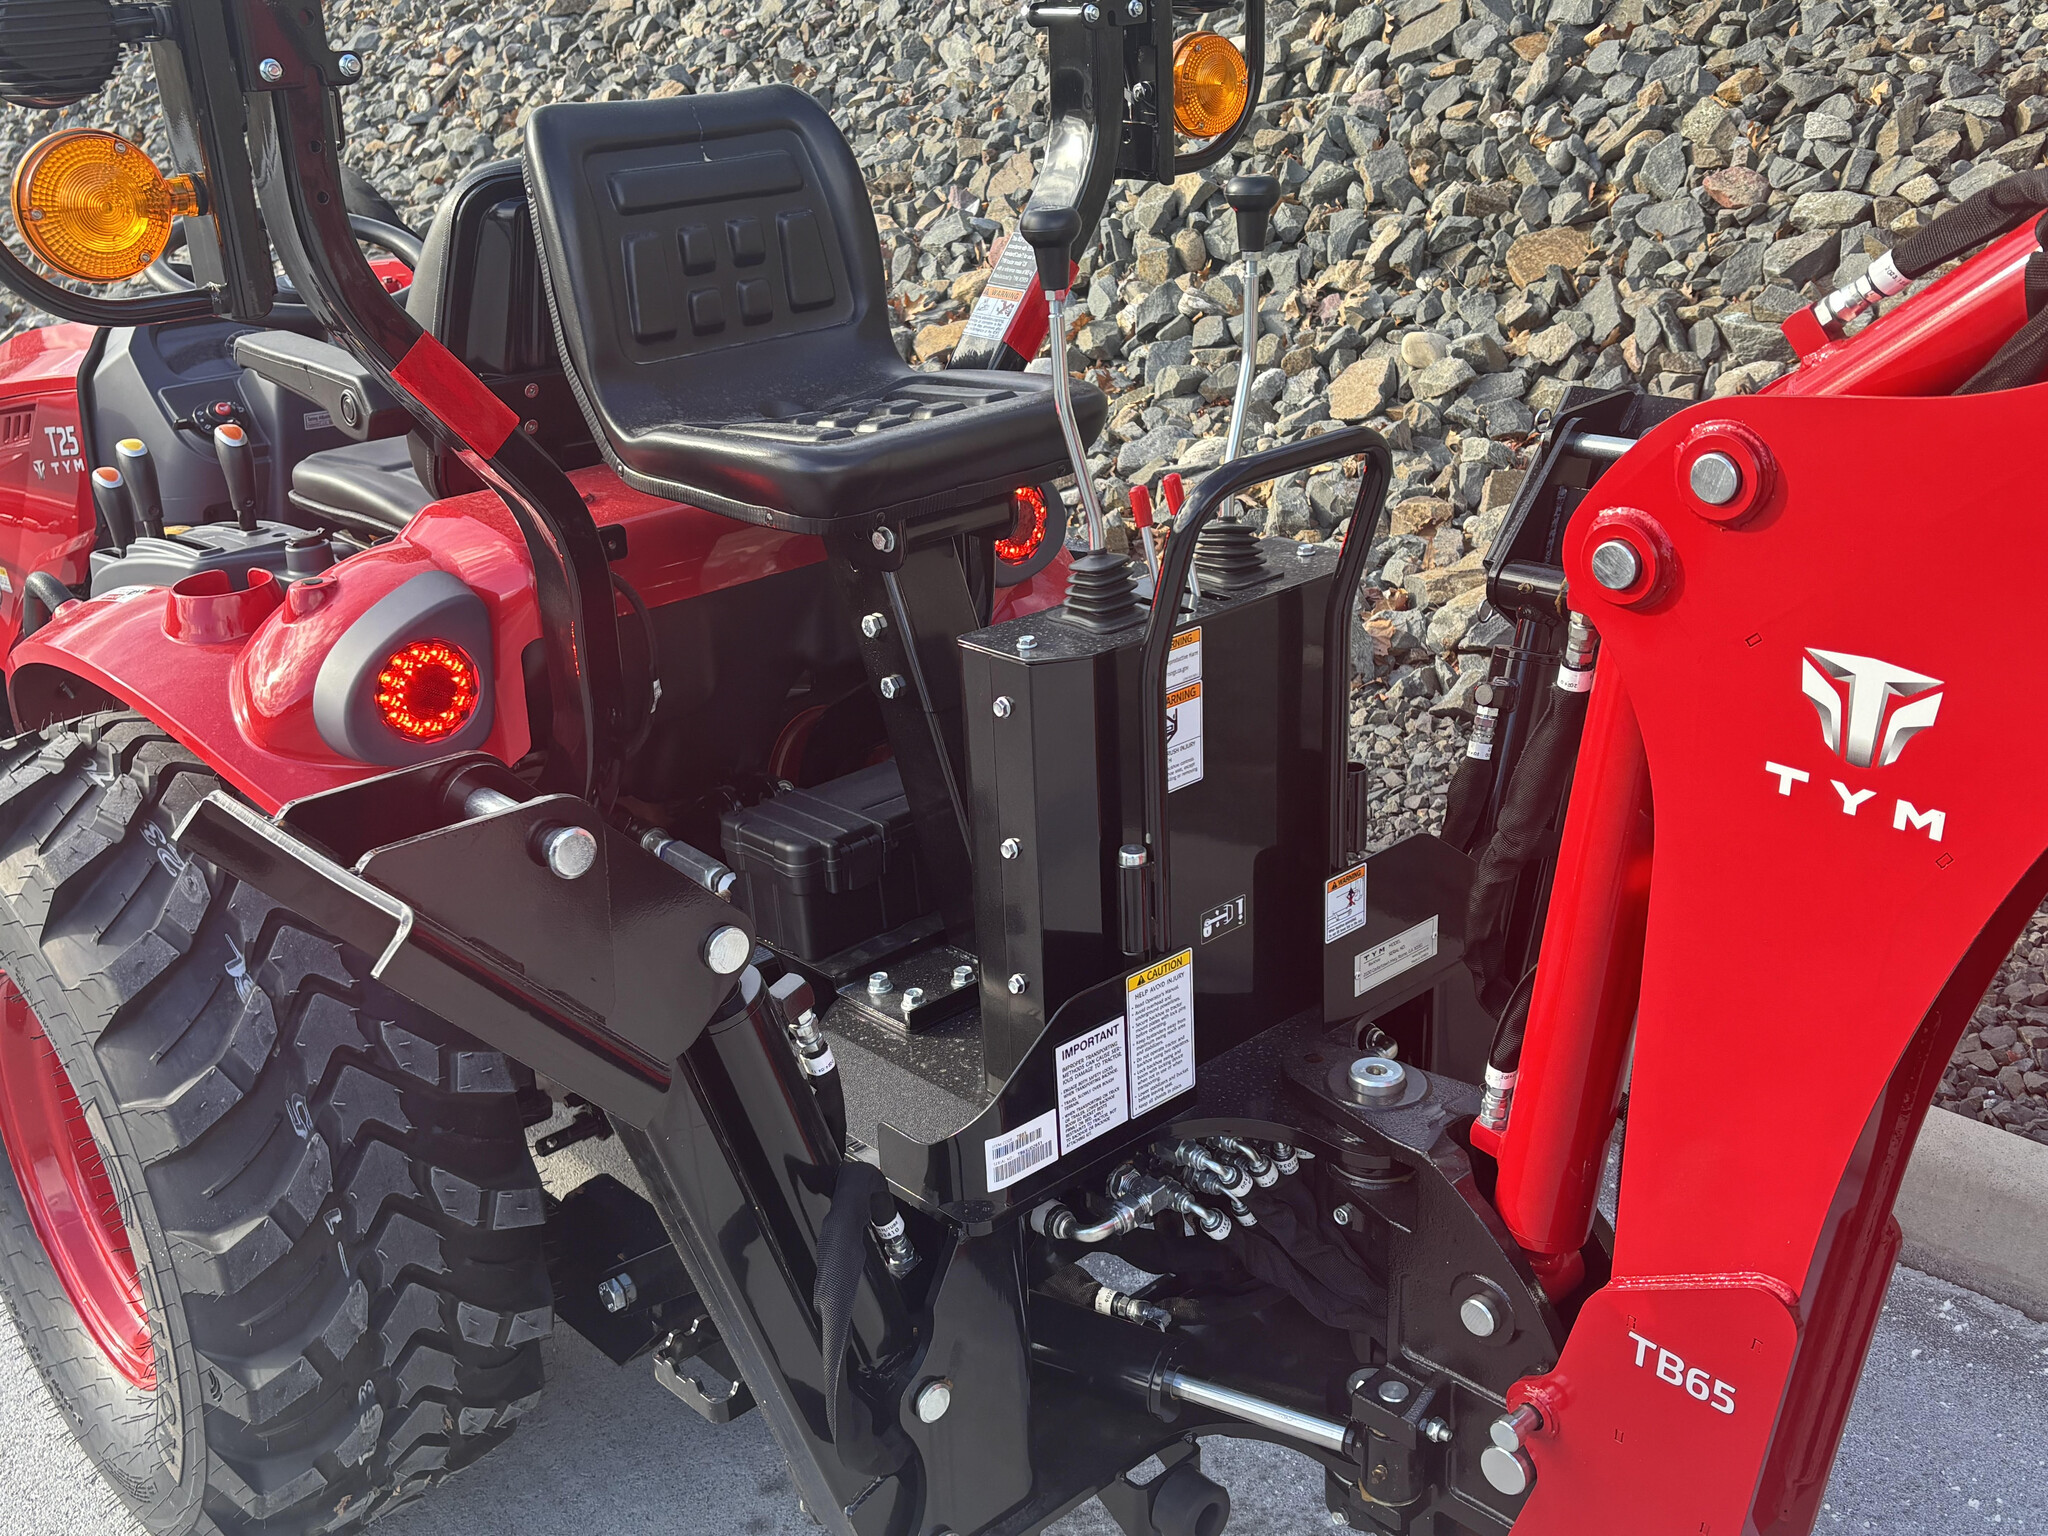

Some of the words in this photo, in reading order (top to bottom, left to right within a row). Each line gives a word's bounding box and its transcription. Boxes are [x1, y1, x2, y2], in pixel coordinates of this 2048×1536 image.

[992, 289, 1020, 300] WARNING
[44, 426, 79, 457] T25
[50, 458, 85, 475] TYM
[1172, 634, 1192, 648] RNING
[1167, 687, 1196, 704] ARNING
[1168, 746, 1179, 756] RUSH
[1766, 760, 1946, 842] TYM
[1338, 868, 1361, 885] WARNING
[1364, 945, 1385, 961] TYM
[1147, 956, 1182, 981] CAUTION
[1134, 988, 1148, 1000] HELP
[1149, 980, 1165, 993] AVOID
[1166, 971, 1184, 984] INJURY
[1135, 1007, 1145, 1015] Avoid
[1146, 998, 1163, 1010] overhead
[1061, 1023, 1119, 1060] IMPORTANT
[1062, 1057, 1084, 1072] IMPROPER
[1085, 1040, 1117, 1060] TRANSPORTING
[1062, 1064, 1084, 1078] METHODS
[1085, 1058, 1094, 1066] CAN
[1096, 1050, 1109, 1061] CAUSE
[1111, 1044, 1121, 1054] SER-
[1628, 1330, 1736, 1414] TB65
